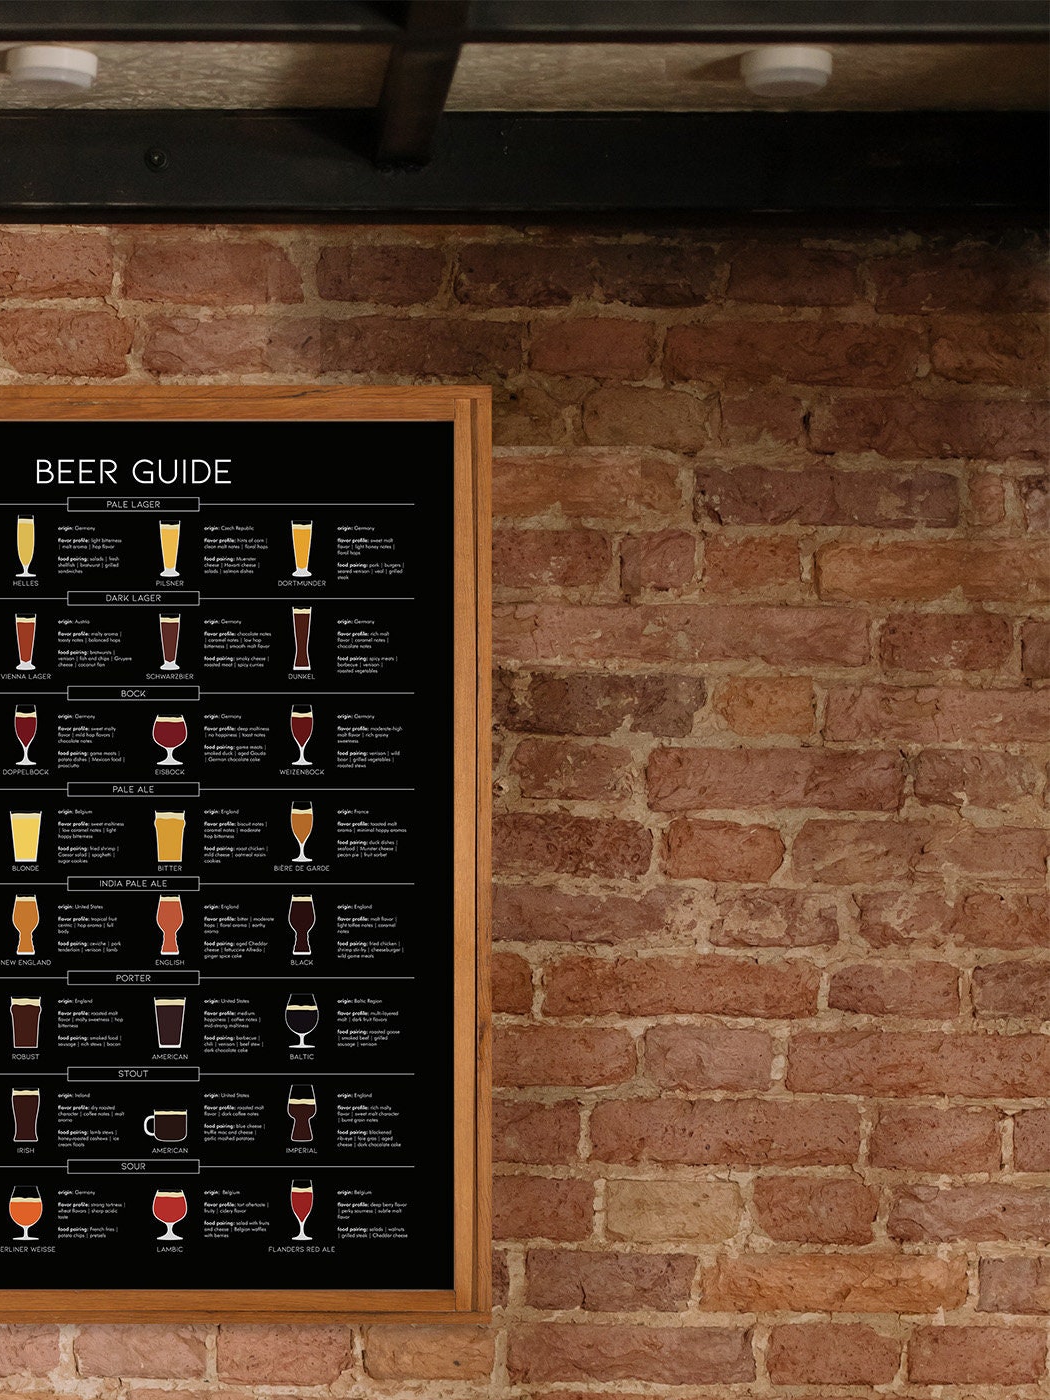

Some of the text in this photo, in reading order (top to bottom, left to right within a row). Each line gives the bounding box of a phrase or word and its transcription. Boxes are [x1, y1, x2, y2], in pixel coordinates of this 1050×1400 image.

[37, 459, 231, 484] BEER GUIDE
[107, 501, 160, 509] PALE LAGER
[106, 594, 161, 602] DARK LAGER
[121, 690, 145, 698] BOCK
[113, 786, 154, 794] PALE ALE
[274, 864, 292, 872] BIÈRE
[100, 880, 167, 888] INDIA PALE ALE
[116, 975, 151, 983] PORTER
[118, 1070, 148, 1078] STOUT
[121, 1163, 145, 1171] SOUR
